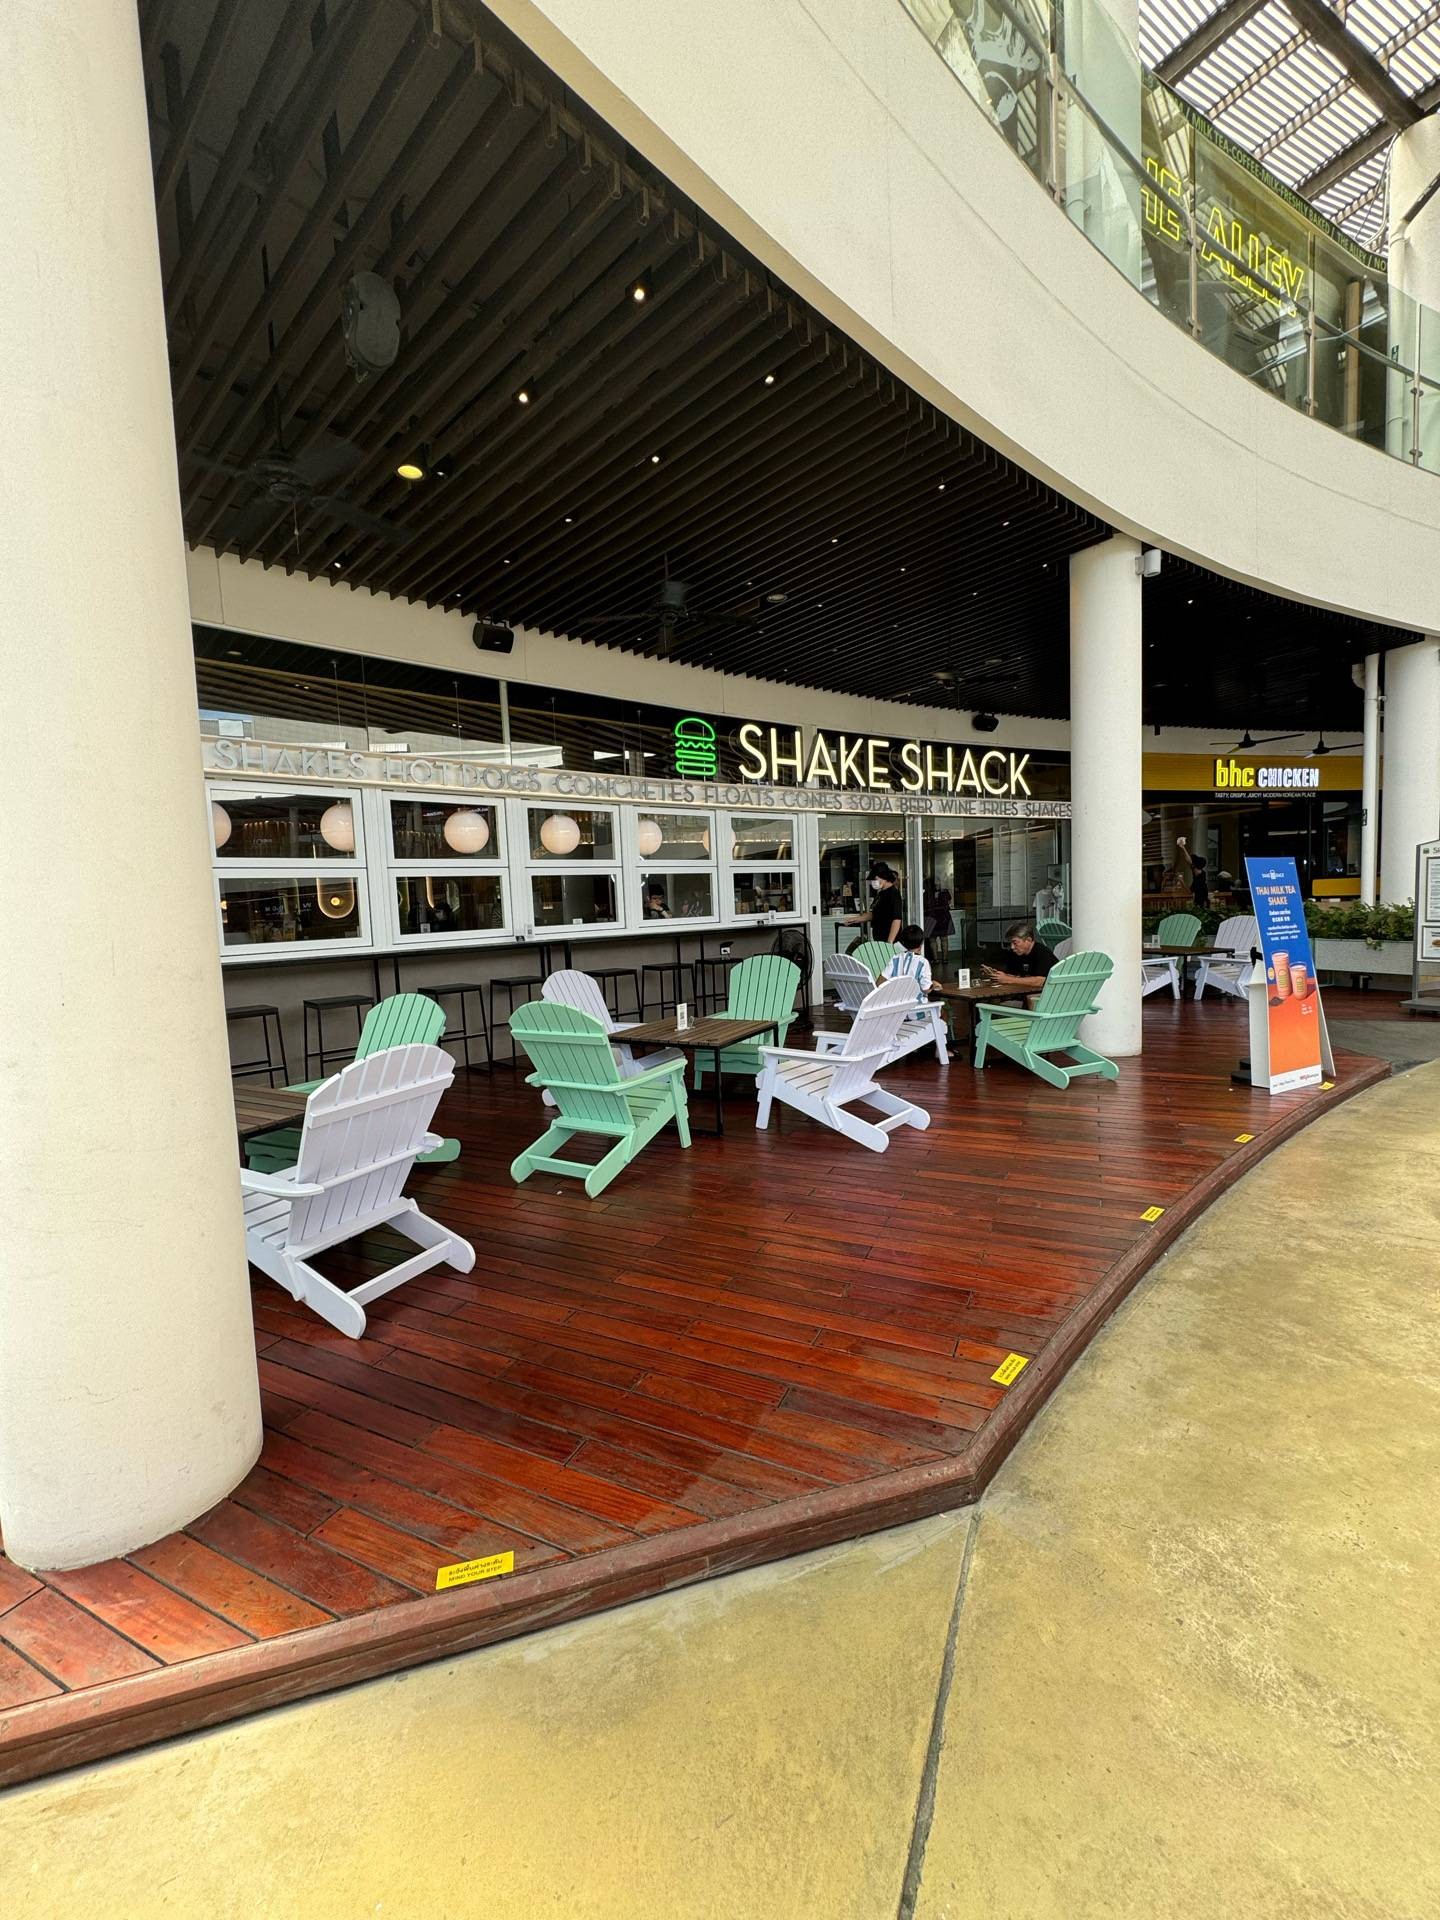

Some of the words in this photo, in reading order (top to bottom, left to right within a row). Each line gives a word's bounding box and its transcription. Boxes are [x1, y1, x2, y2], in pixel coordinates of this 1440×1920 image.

[1192, 113, 1213, 140] MILK
[1309, 210, 1331, 236] BAKED
[1337, 231, 1348, 248] THE
[1349, 242, 1366, 263] ALLEY
[1201, 207, 1304, 317] ALLEY
[214, 739, 368, 780] SHAKES
[384, 756, 450, 787] HOT
[461, 763, 542, 793] DOGS
[555, 772, 696, 803] CONCRETES
[705, 785, 775, 808] FLOATS
[782, 791, 843, 811] CONES
[850, 794, 893, 813] SODA
[900, 796, 933, 815] BEER
[939, 799, 977, 816] WINE
[982, 800, 1019, 817] FRIES
[1024, 802, 1072, 818] SHAKES
[738, 724, 891, 789] SHAKE
[900, 743, 1032, 796] SHACK
[1215, 759, 1254, 787] bhc
[1257, 767, 1320, 788] CHICKEN
[1256, 886, 1270, 895] THAI
[1271, 886, 1284, 894] MILK
[1285, 886, 1296, 894] TEA
[1268, 896, 1288, 905] SHAKE
[449, 1574, 466, 1582] MIND
[467, 1569, 485, 1577] YOUR
[486, 1565, 502, 1573] STEP
